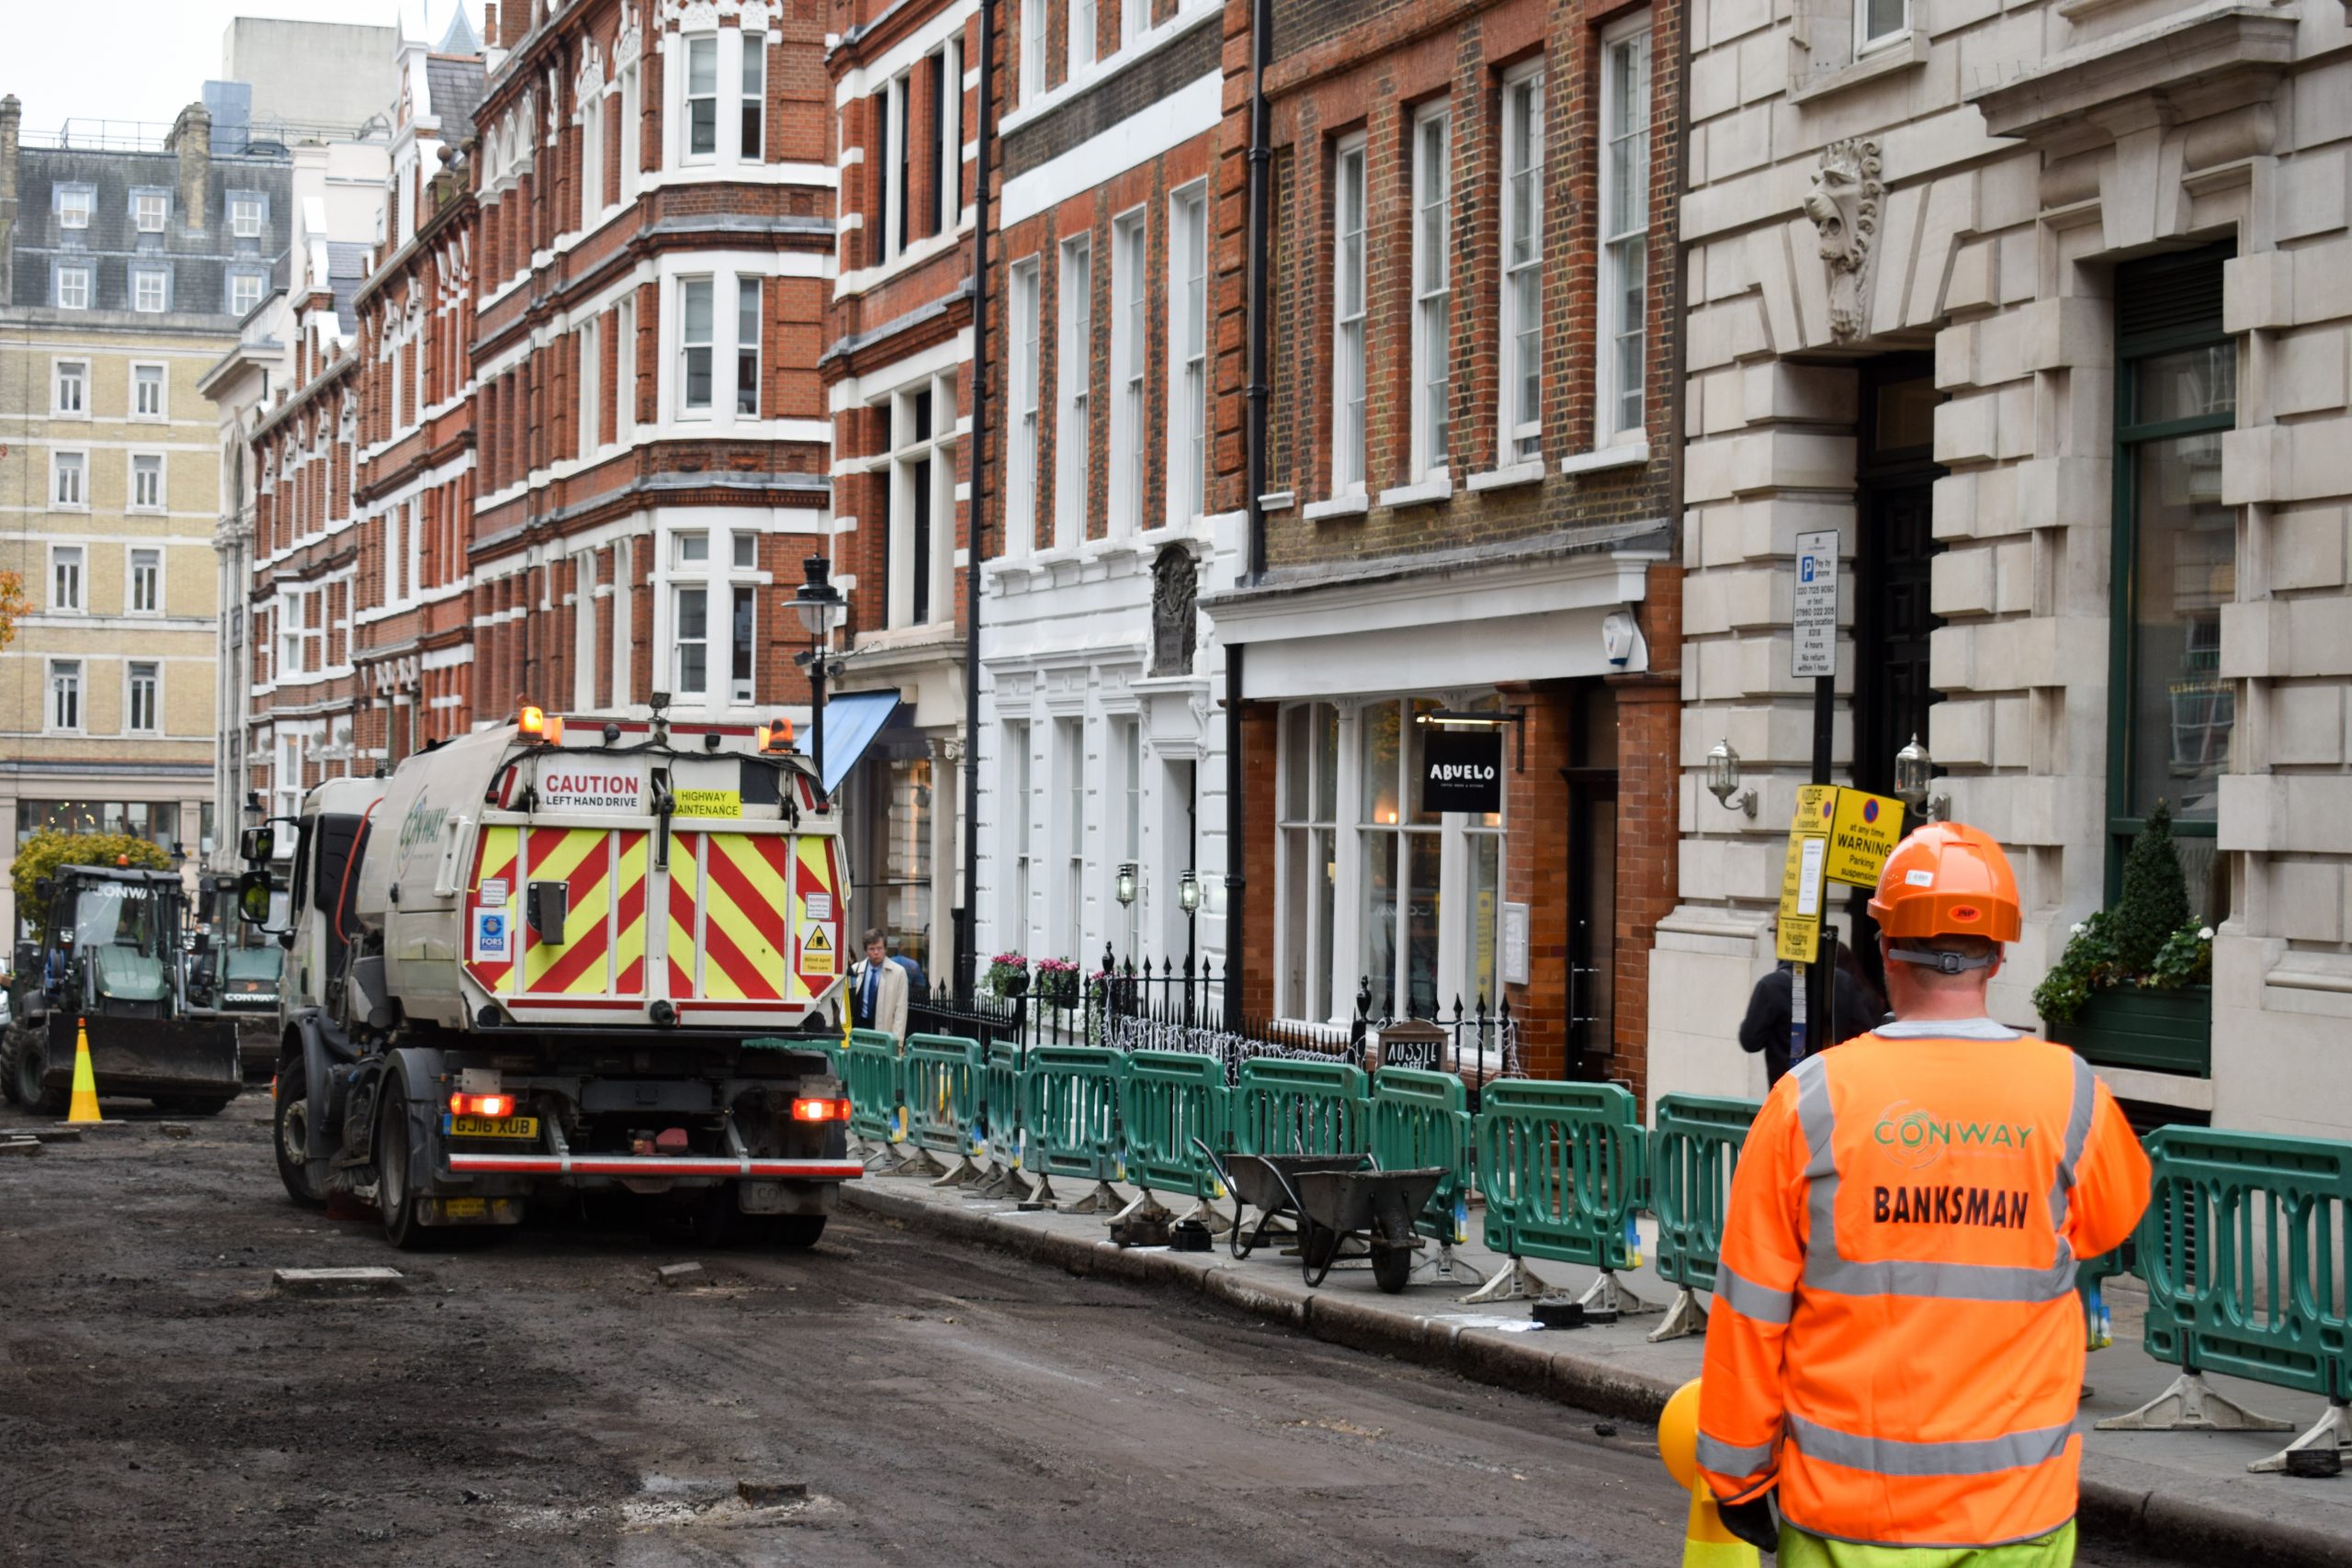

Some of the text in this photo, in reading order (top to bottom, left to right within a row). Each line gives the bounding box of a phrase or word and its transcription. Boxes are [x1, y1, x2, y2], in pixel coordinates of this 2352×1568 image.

[1804, 558, 1813, 580] P
[1815, 559, 1831, 568] Pay by
[1815, 570, 1829, 578] phone
[1795, 619, 1813, 627] quoting
[1798, 663, 1812, 671] within
[1430, 764, 1495, 780] ABUELO
[546, 774, 639, 794] CAUTION
[546, 795, 638, 807] LEFT HAND DRIVE
[682, 792, 727, 802] HIGHWAY
[675, 805, 739, 816] AINTENANCE
[400, 807, 449, 847] CONWAY
[1849, 824, 1884, 839] at any time
[1838, 833, 1893, 858] WARNING
[1849, 854, 1875, 871] Parking
[1840, 868, 1878, 882] suspension
[1957, 908, 1975, 918] JSP
[481, 938, 503, 946] FORS
[224, 994, 277, 1002] CONWAY
[1387, 1043, 1437, 1062] AUSSIE
[456, 1117, 530, 1134] GJ16 XUB
[1874, 1120, 2033, 1148] CONWAY
[1873, 1185, 2029, 1229] BANKSMAN
